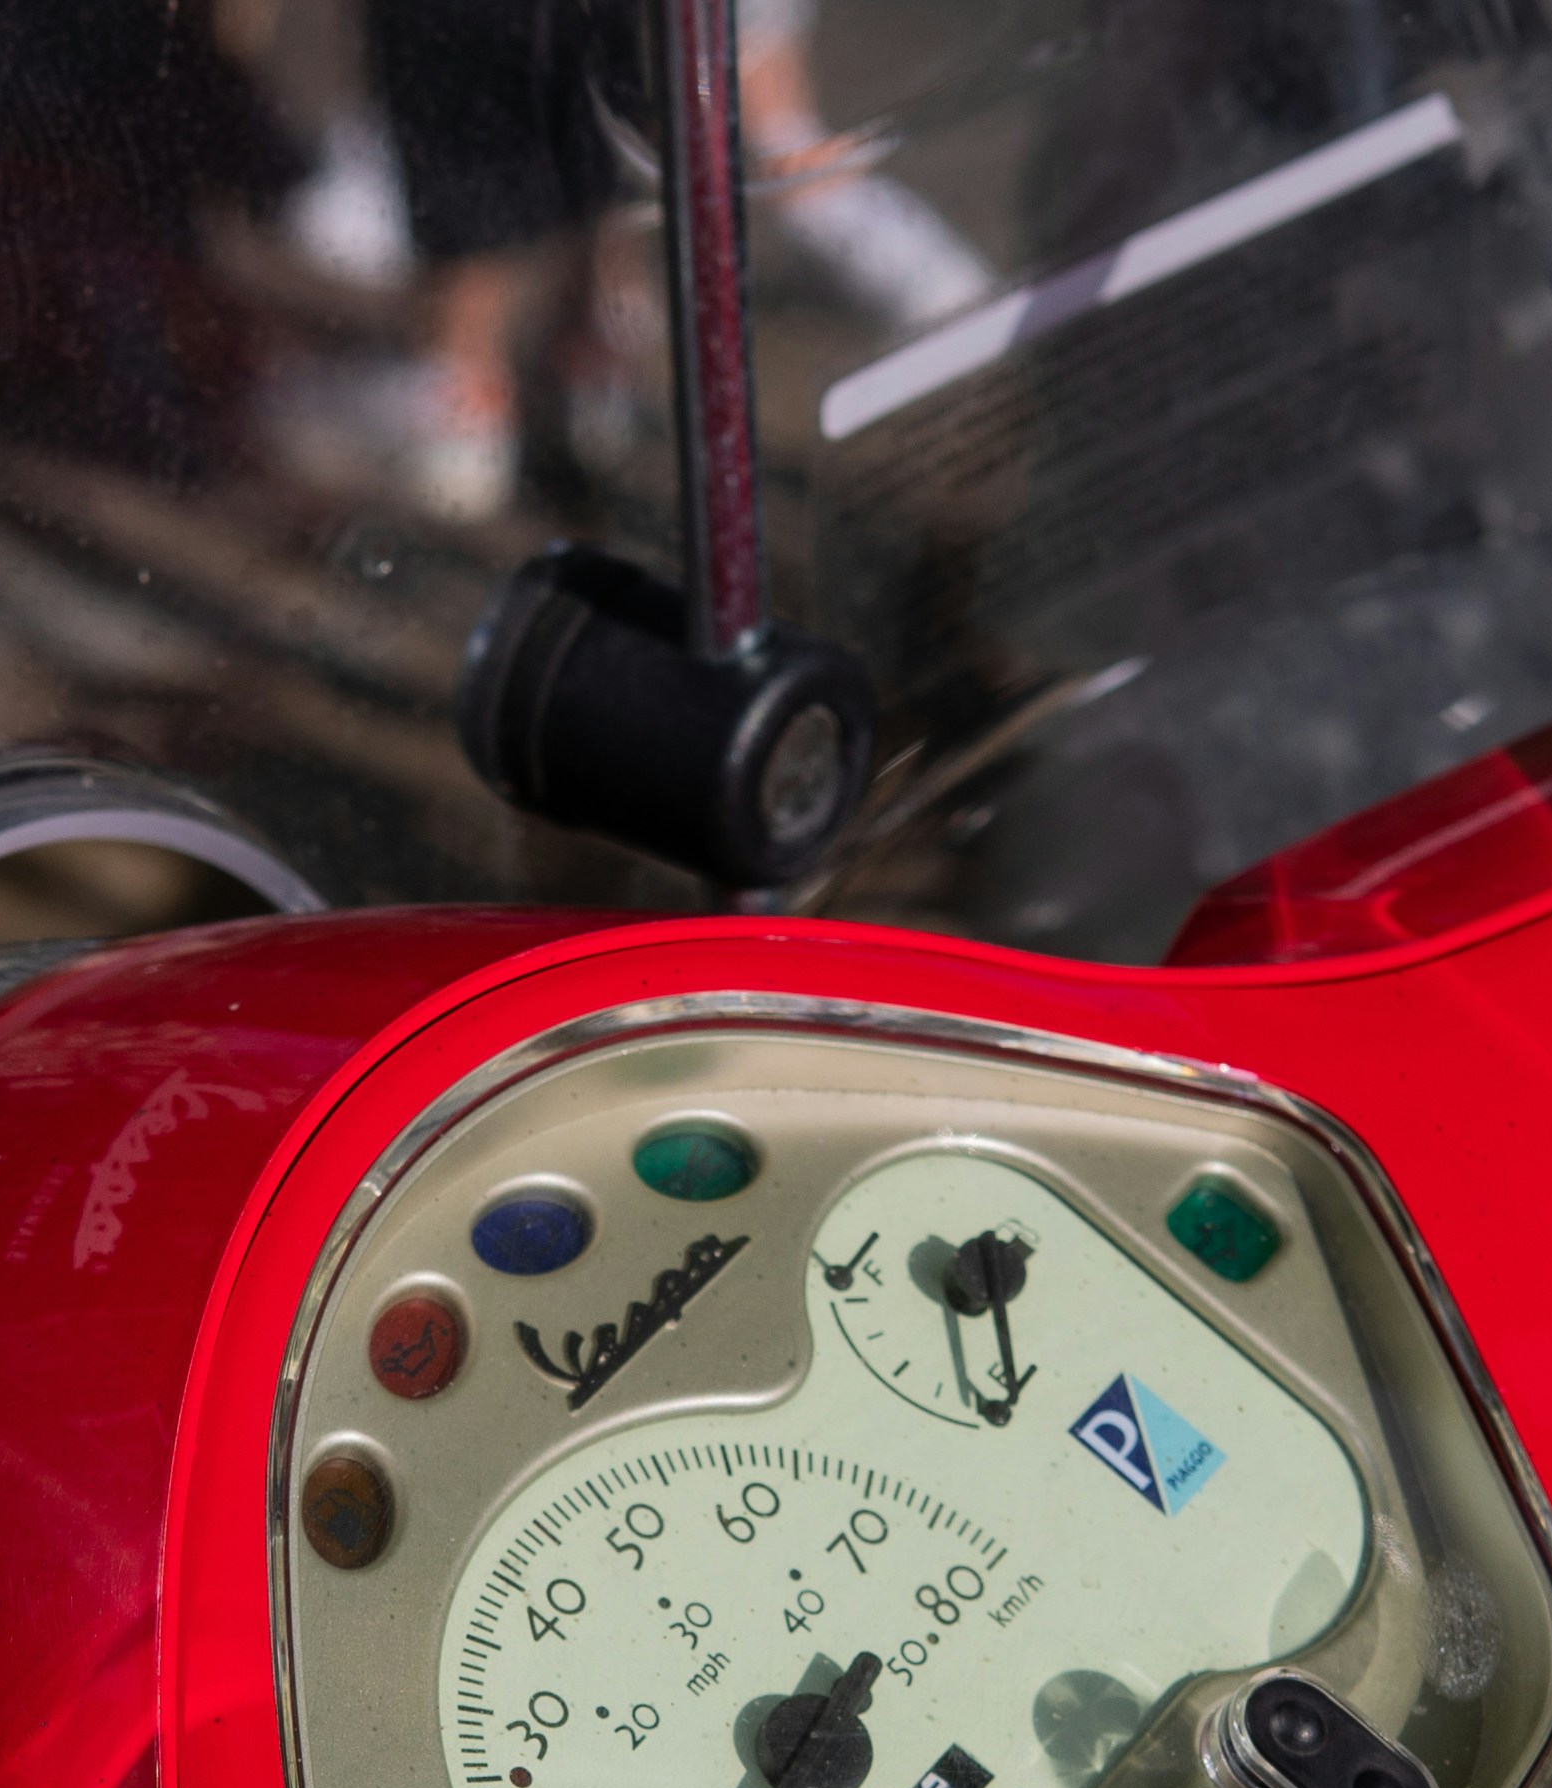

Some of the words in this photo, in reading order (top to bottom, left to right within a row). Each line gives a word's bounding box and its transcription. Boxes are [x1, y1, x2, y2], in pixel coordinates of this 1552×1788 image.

[862, 1259, 883, 1287] F
[513, 1234, 751, 1412] Vespa
[1077, 1409, 1153, 1492] P
[606, 1503, 664, 1571] 50
[716, 1482, 780, 1543] 60
[825, 1509, 888, 1574] 70
[527, 1578, 586, 1642] 40
[783, 1589, 824, 1633] 40
[915, 1565, 984, 1625] 80
[987, 1574, 1045, 1628] km/h
[669, 1602, 712, 1650] 30
[686, 1652, 732, 1696] mph
[886, 1640, 928, 1687] 50
[505, 1691, 569, 1761] 30
[614, 1703, 660, 1750] 20
